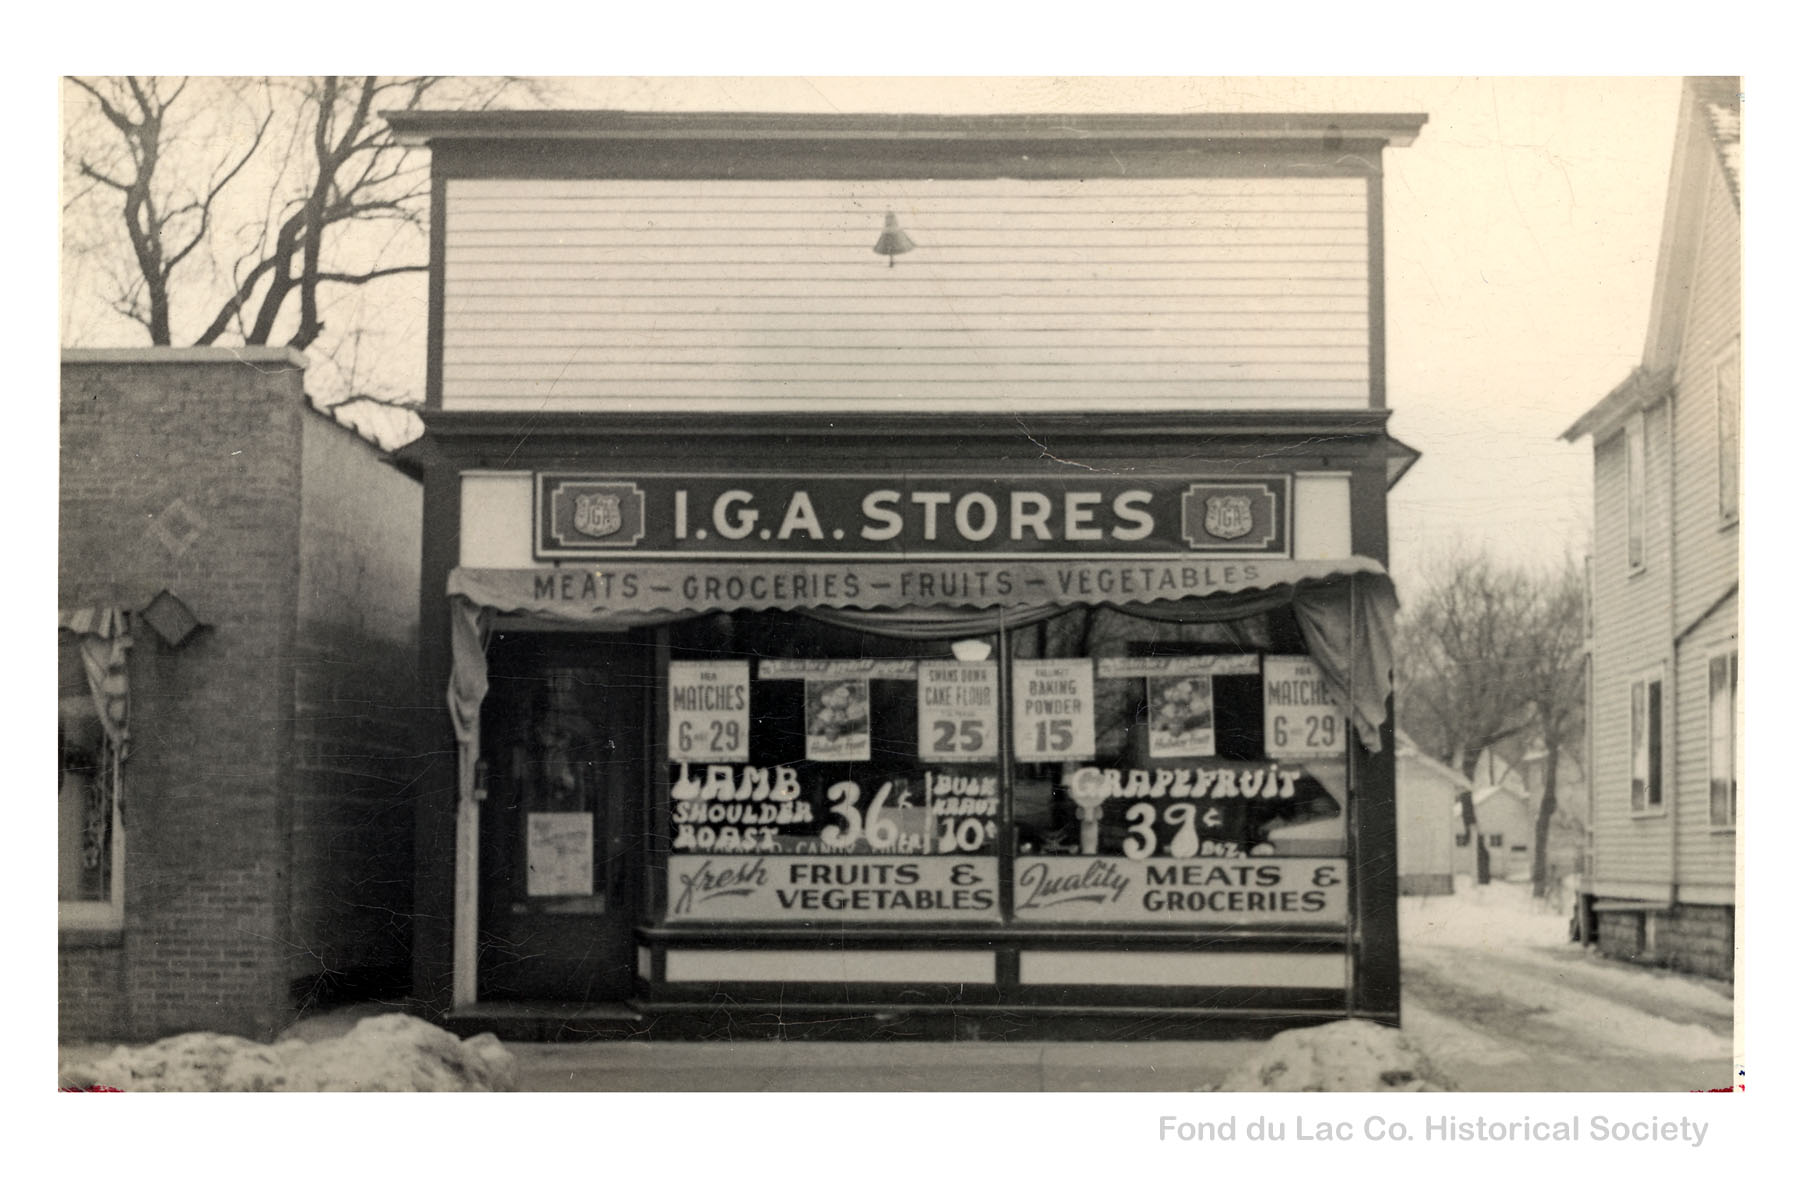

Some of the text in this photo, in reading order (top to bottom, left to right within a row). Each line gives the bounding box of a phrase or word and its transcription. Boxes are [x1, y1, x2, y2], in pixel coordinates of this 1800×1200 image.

[674, 490, 1155, 542] I.G.A. STORES
[1217, 508, 1242, 527] IGA
[534, 573, 639, 600] MEATS
[682, 573, 861, 600] GROCERIES
[901, 570, 1013, 598] FRUITS
[1057, 564, 1260, 595] VEGETABLES
[673, 685, 745, 711] MATCHES
[925, 686, 991, 706] CAKE FLOUR
[1029, 680, 1077, 696] BAKING
[1025, 698, 1082, 716] POWDER
[679, 719, 740, 752] 6 29
[933, 720, 984, 752] 25
[1035, 719, 1074, 752] 15
[1274, 714, 1335, 747] 6 29
[671, 761, 801, 801] LAMB
[933, 775, 997, 796] BULK
[672, 800, 813, 824] SHOULDER
[932, 797, 999, 816] KRAUT
[673, 824, 779, 850] ROAST
[674, 858, 983, 914] fresh FRUITS &
[1016, 860, 1341, 911] Quality MEATS &
[776, 889, 993, 910] VEGETABLES
[1143, 890, 1327, 912] GROCERIES
